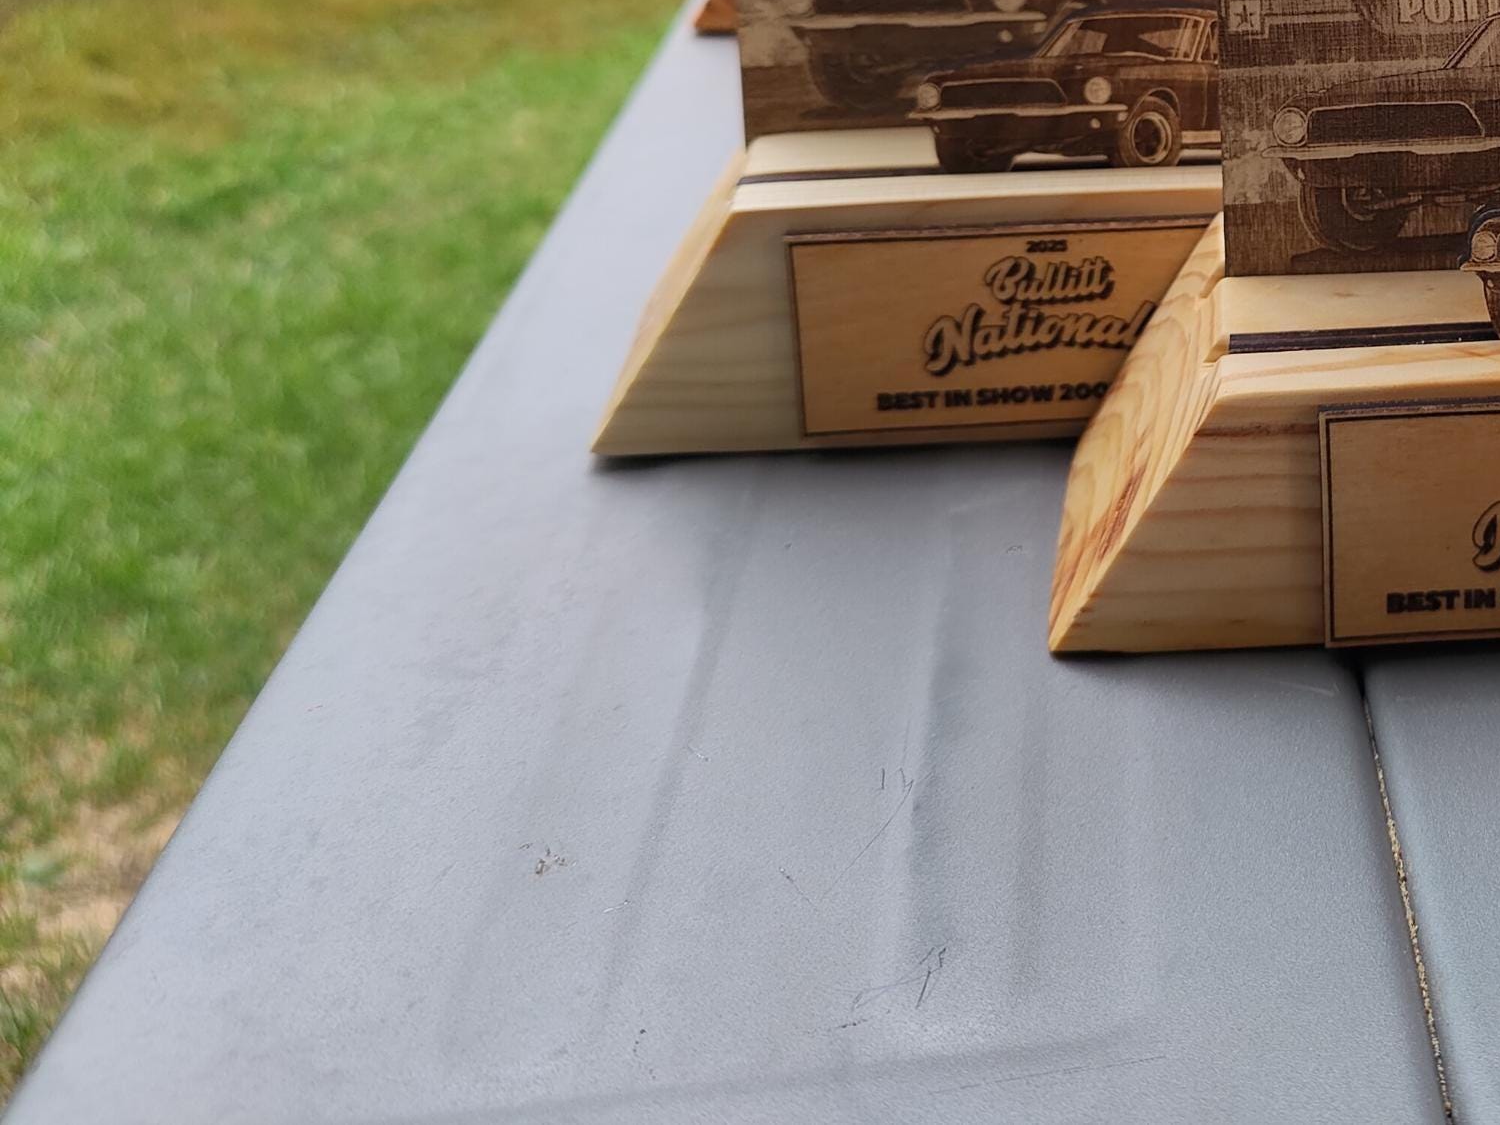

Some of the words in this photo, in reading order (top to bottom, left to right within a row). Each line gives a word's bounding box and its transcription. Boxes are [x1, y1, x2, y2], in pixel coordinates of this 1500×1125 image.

[1026, 239, 1069, 253] 2025
[985, 256, 1115, 305] Bullitt
[923, 300, 1158, 376] National
[877, 388, 940, 412] BEST
[944, 386, 974, 408] IN
[976, 383, 1057, 406] SHOW
[1386, 590, 1461, 615] BEST
[1464, 588, 1497, 610] IN
